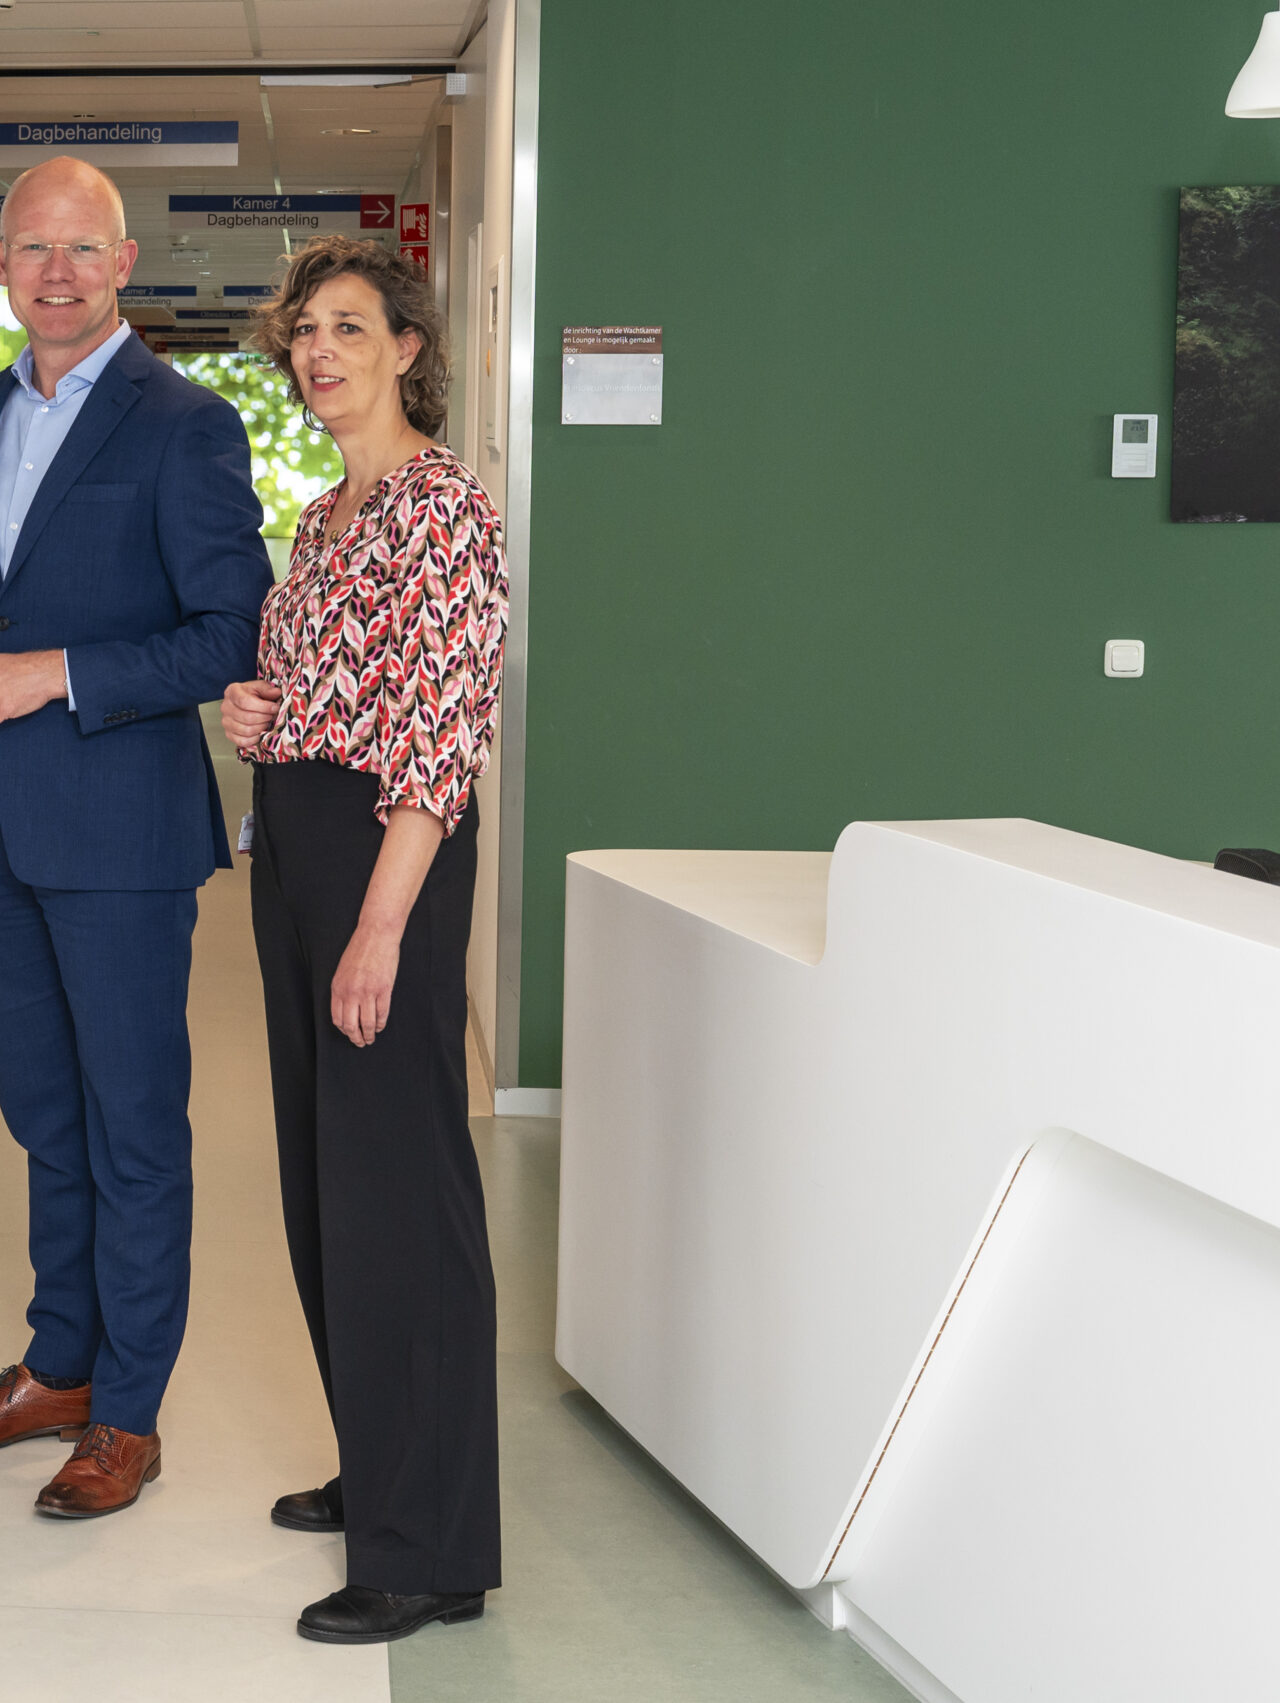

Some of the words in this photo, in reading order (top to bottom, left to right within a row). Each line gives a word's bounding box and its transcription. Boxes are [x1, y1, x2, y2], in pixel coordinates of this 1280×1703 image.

[18, 124, 162, 144] Dagbehandeling
[232, 197, 278, 210] Kamer
[282, 197, 291, 209] 4
[207, 213, 319, 229] Dagbehandeling
[148, 287, 155, 296] 2
[572, 327, 601, 335] inrichting
[614, 327, 623, 335] de
[623, 327, 661, 335] Wachtkamer
[572, 336, 596, 345] Lounge
[596, 336, 602, 344] is
[602, 336, 629, 345] mogelijk
[629, 336, 656, 345] gemaakt
[563, 346, 578, 354] door
